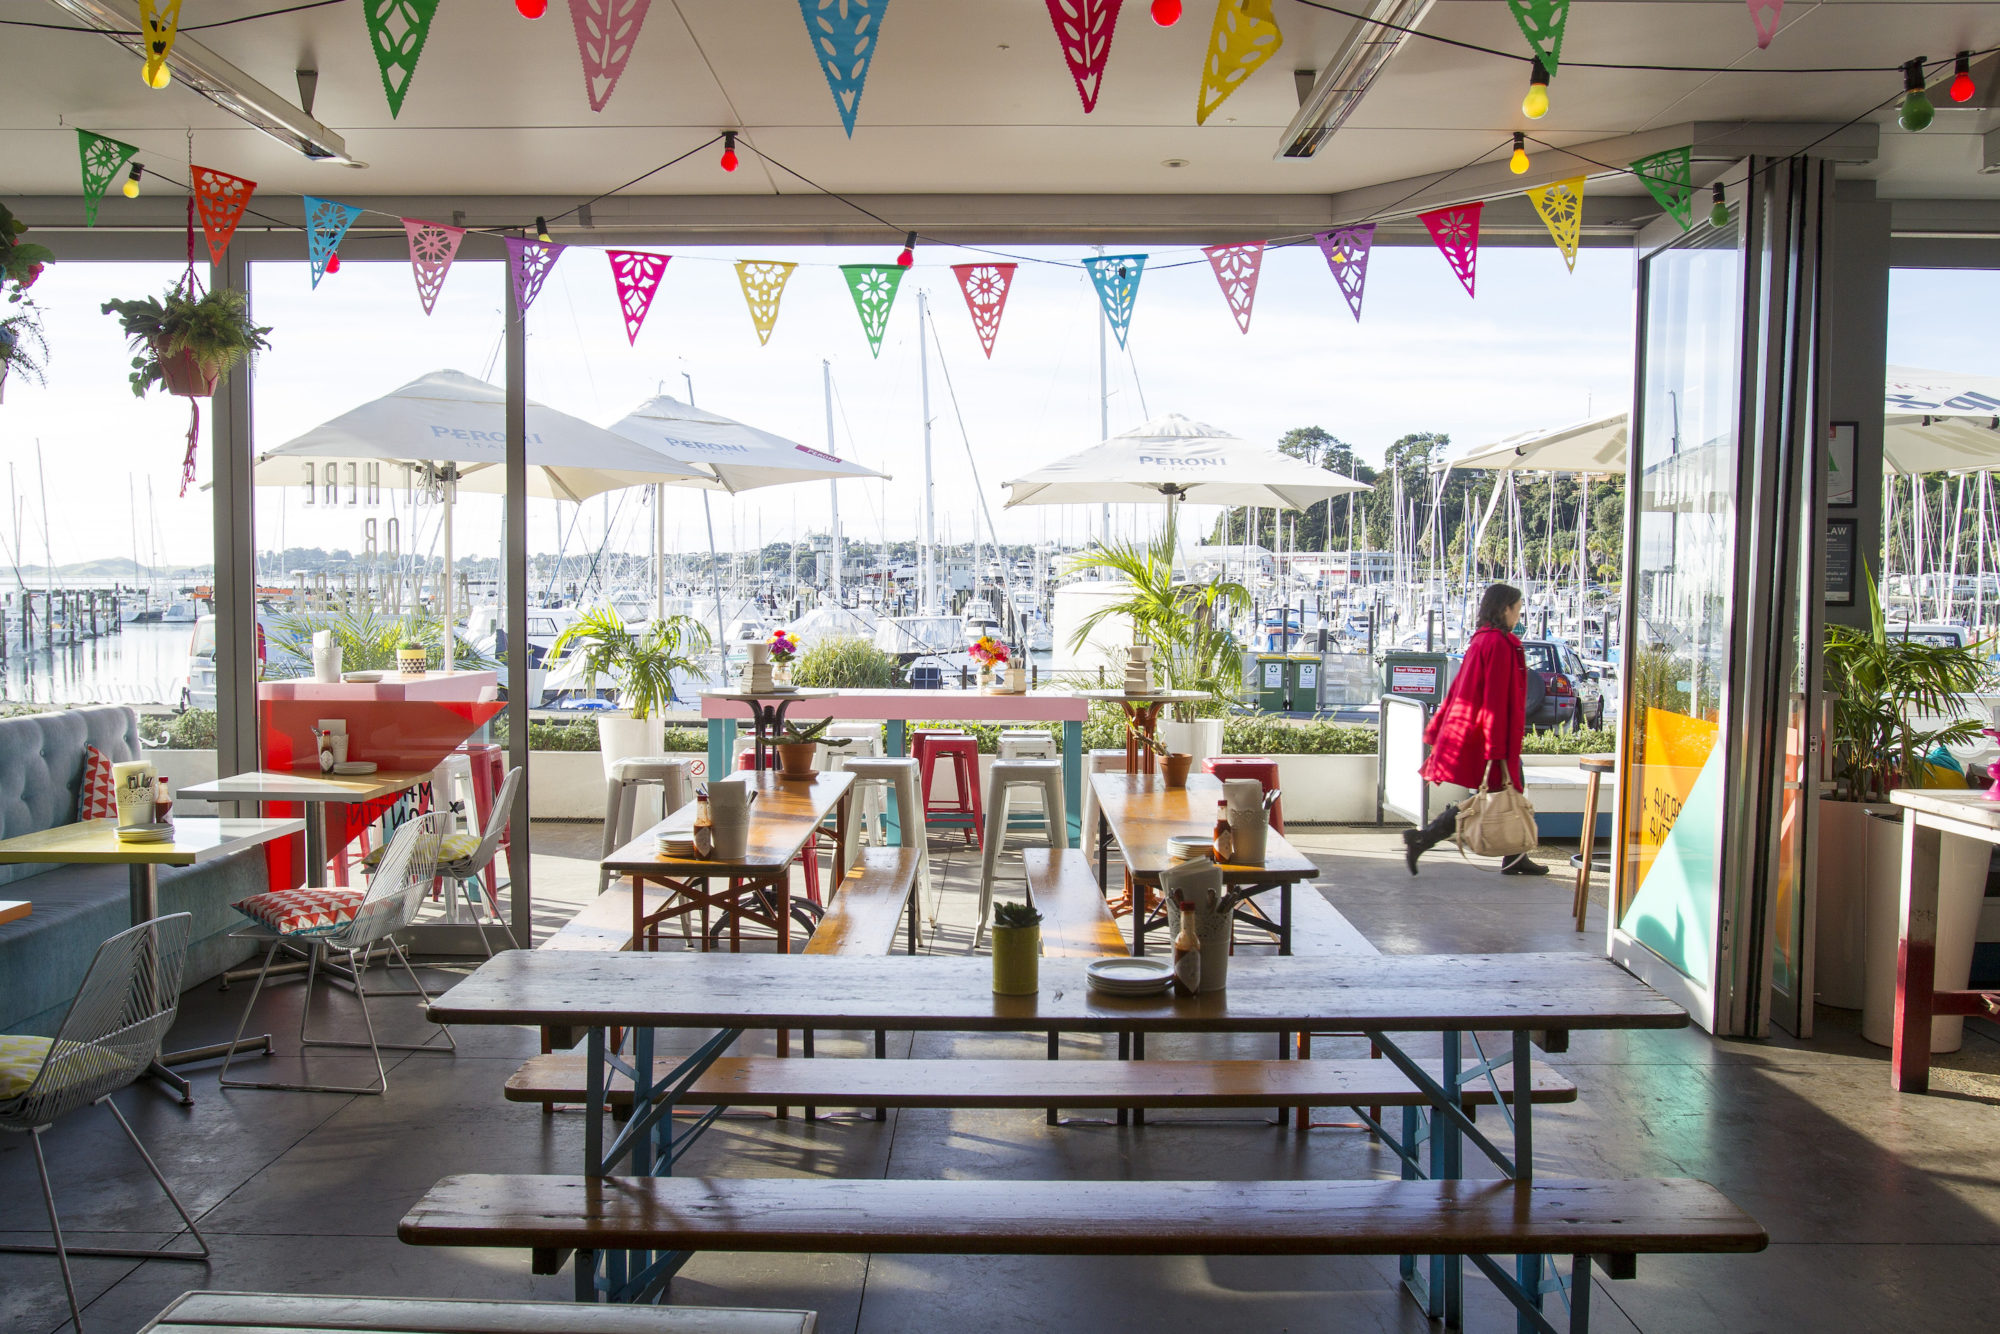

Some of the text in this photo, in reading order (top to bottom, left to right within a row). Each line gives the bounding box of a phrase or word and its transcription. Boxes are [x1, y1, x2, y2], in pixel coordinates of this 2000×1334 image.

[430, 425, 543, 444] PEROI
[664, 437, 750, 453] PERONI
[1139, 455, 1228, 466] PERONI
